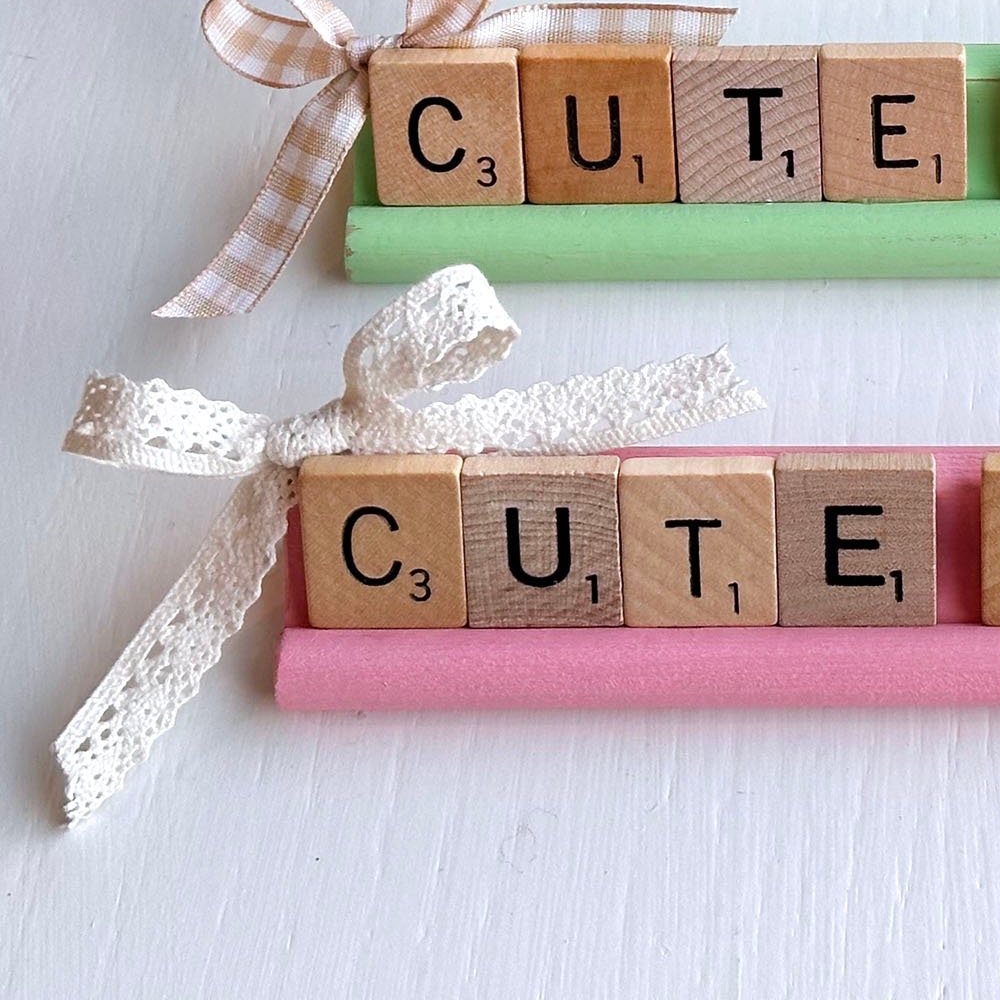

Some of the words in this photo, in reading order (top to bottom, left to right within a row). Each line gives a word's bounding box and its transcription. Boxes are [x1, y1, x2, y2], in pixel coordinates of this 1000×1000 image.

[475, 155, 499, 189] 3
[630, 153, 645, 186] 1
[779, 148, 796, 180] 1
[932, 152, 944, 186] 1
[408, 567, 433, 603] 3
[583, 572, 600, 606] 1
[726, 581, 741, 616] 1
[887, 568, 905, 604] 1
